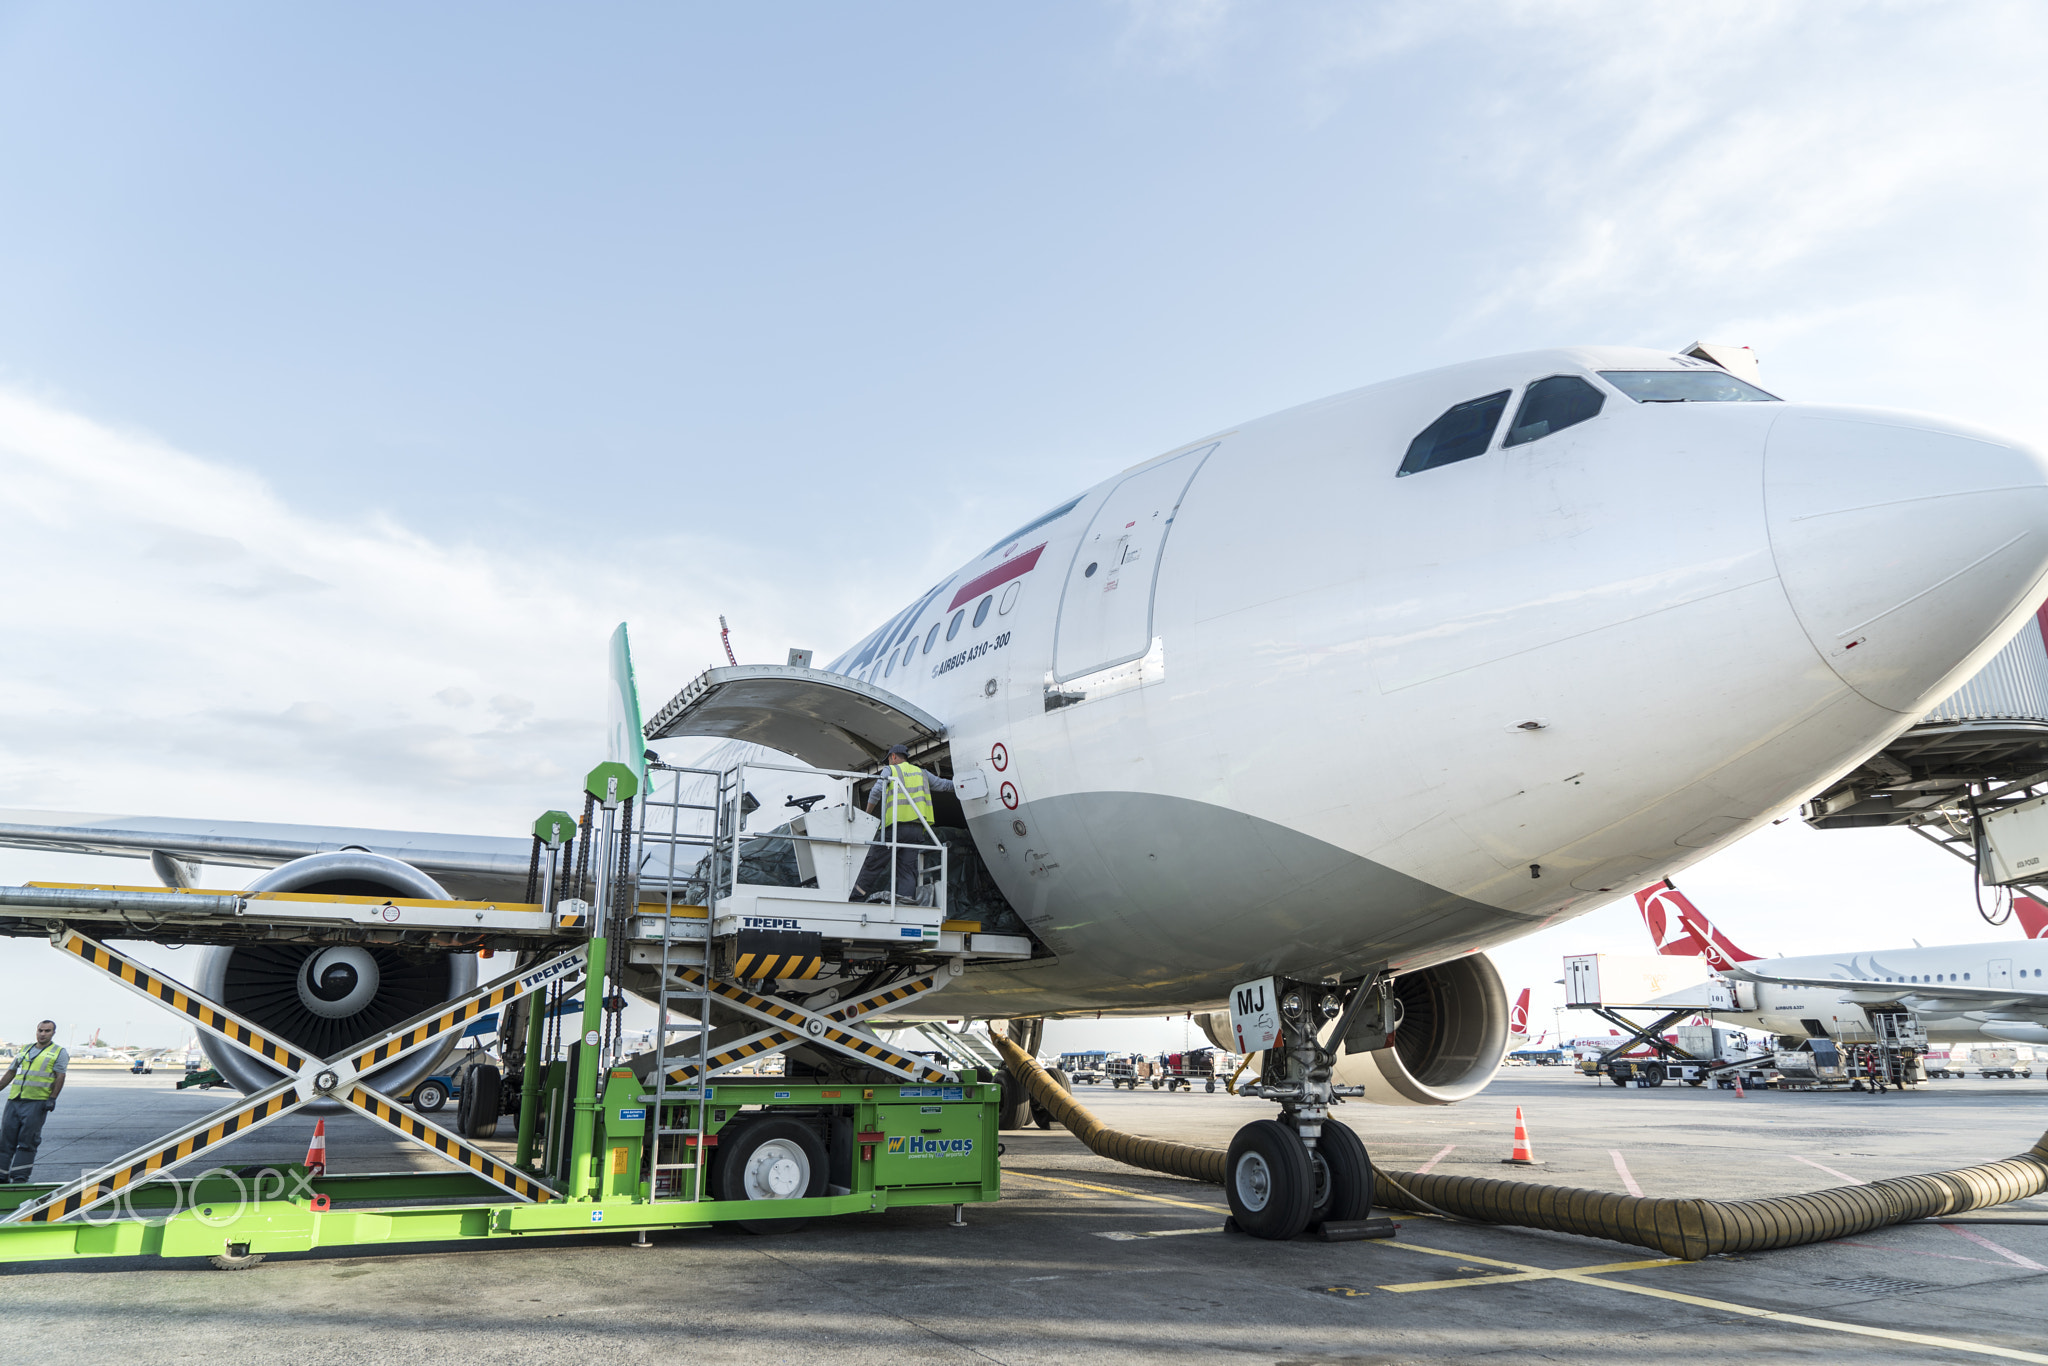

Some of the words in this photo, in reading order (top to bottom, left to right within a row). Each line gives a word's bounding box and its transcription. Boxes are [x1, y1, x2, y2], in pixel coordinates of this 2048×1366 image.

[938, 650, 967, 676] AIRBUS
[967, 630, 1011, 662] A310-300
[742, 917, 802, 930] TREPEL
[521, 954, 583, 988] TREPEL
[1237, 985, 1265, 1016] MJ
[1711, 994, 1724, 1003] 101
[909, 1135, 973, 1157] Havaş
